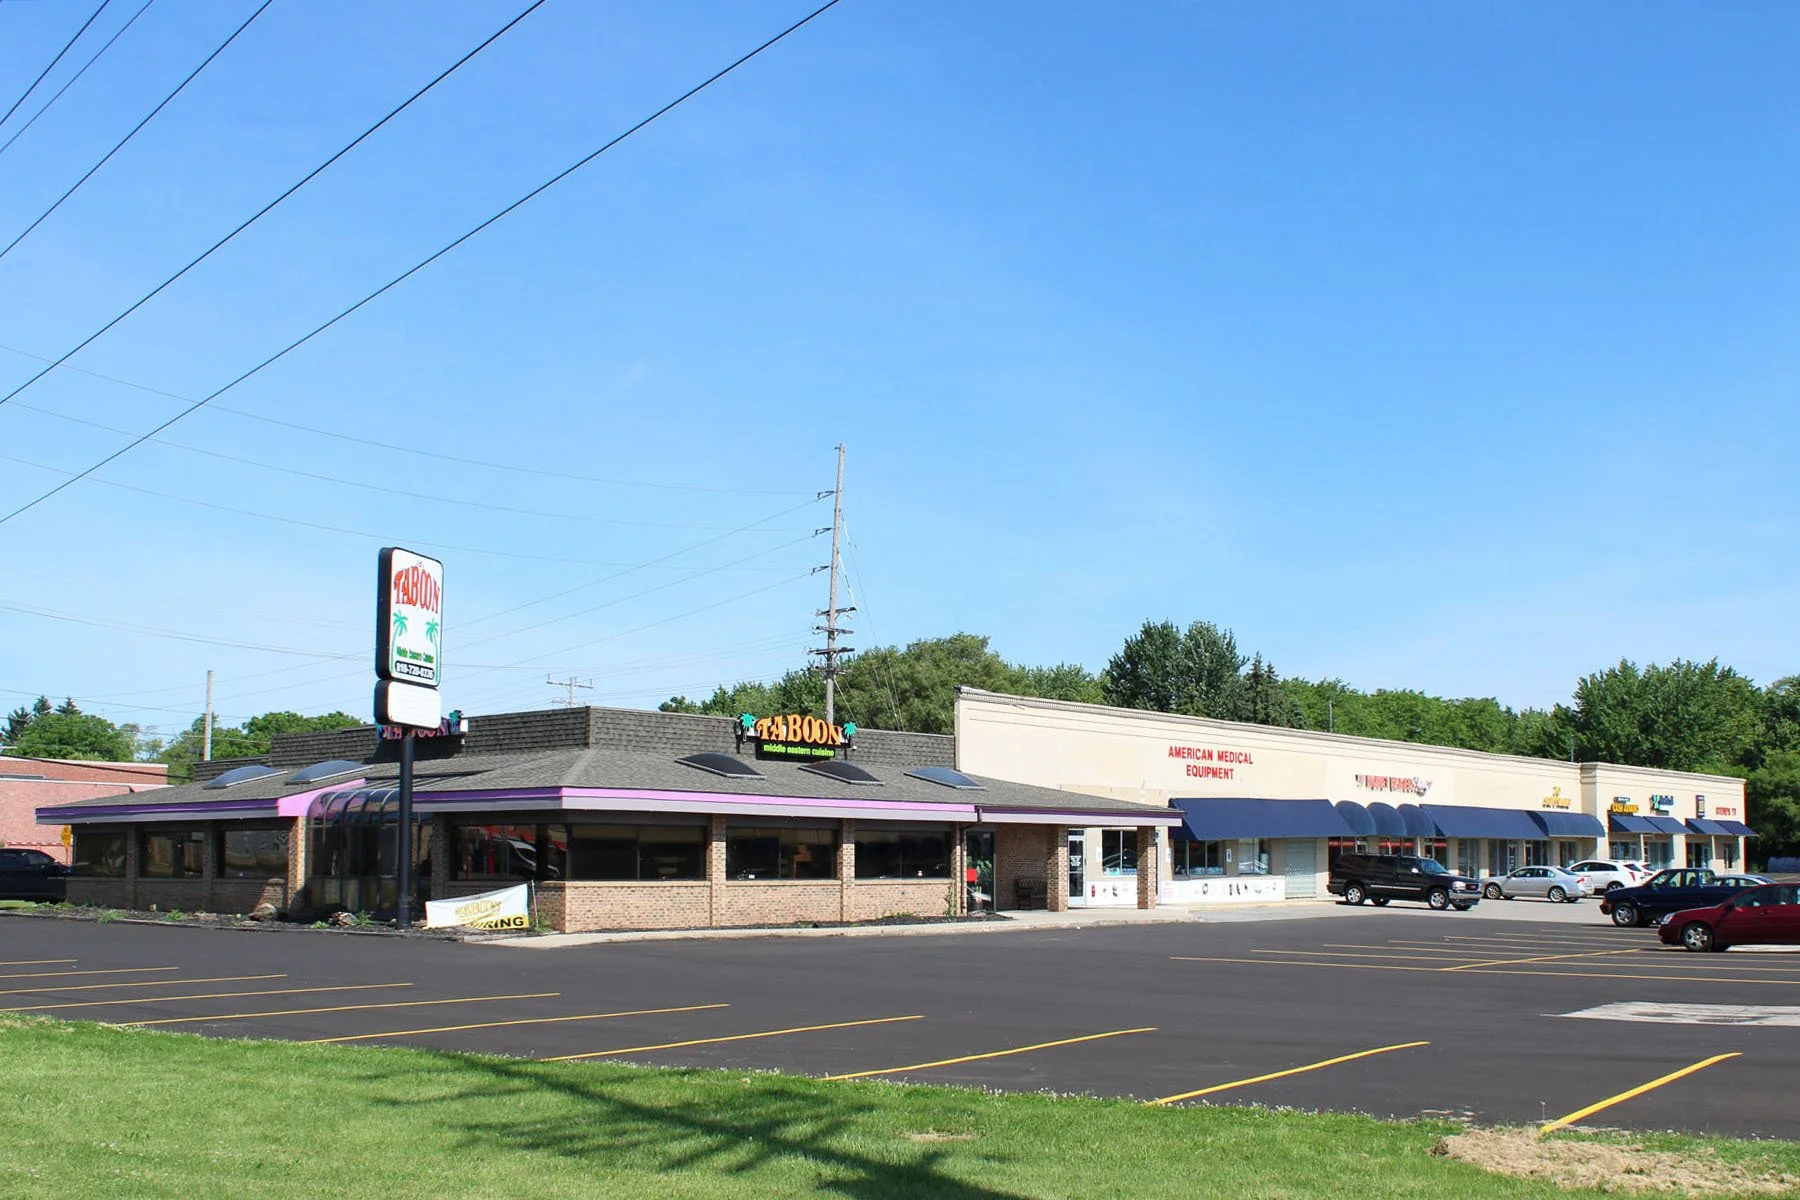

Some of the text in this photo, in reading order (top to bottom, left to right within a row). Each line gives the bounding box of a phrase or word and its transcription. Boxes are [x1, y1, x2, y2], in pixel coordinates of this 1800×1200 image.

[394, 566, 440, 614] TABOON
[755, 713, 843, 746] TABOON
[763, 744, 834, 757] middle eastern cuisine
[1168, 745, 1253, 765] AMERICAN MEDICAL
[1186, 765, 1234, 780] EQUIPMENT
